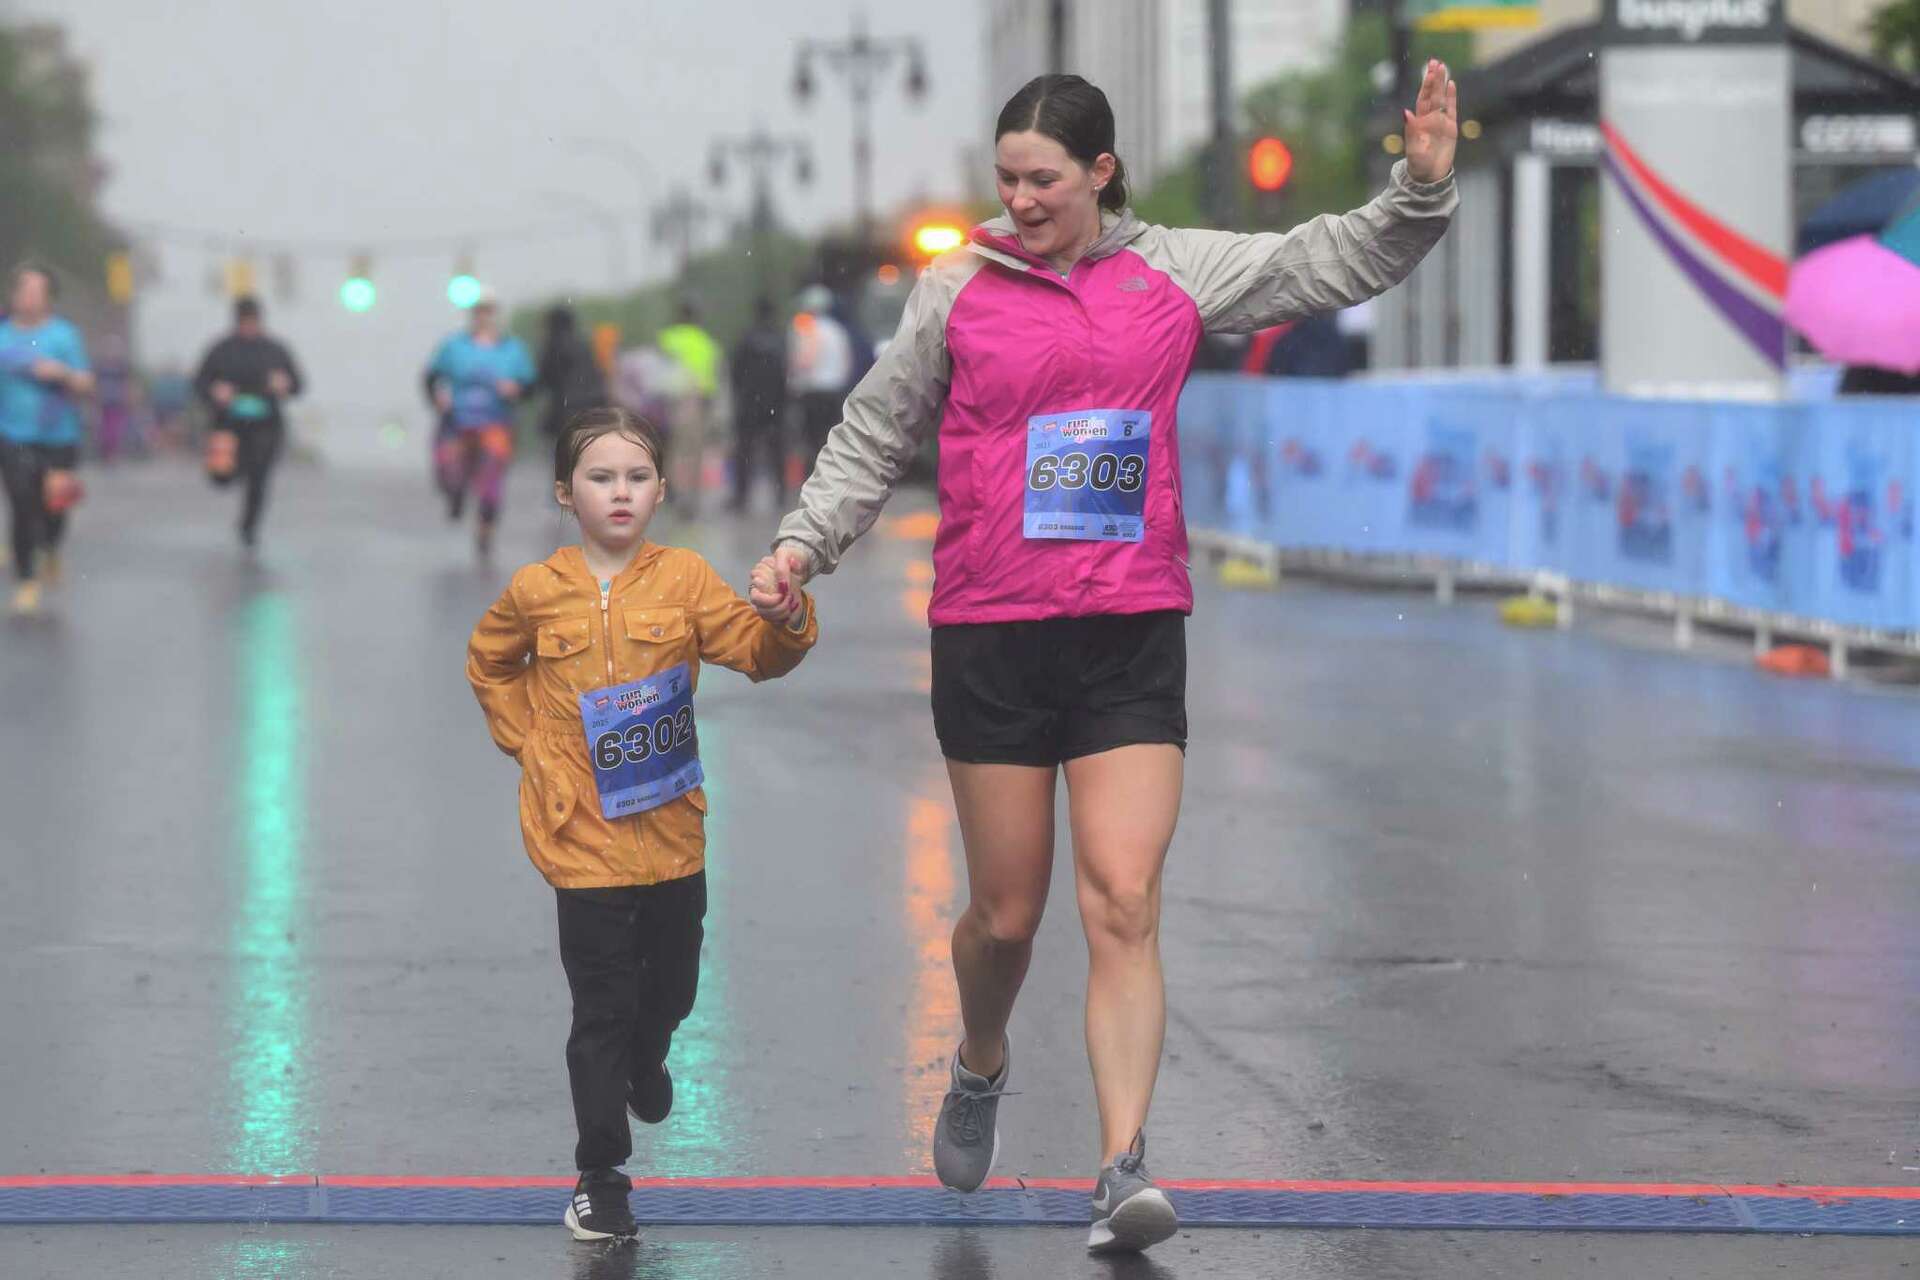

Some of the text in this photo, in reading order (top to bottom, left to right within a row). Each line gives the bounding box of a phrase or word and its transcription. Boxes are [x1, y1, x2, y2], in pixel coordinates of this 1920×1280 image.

[1067, 419, 1089, 428] run
[1123, 425, 1133, 437] 6
[1028, 452, 1145, 493] 6303
[619, 689, 642, 702] run
[594, 704, 693, 771] 6302
